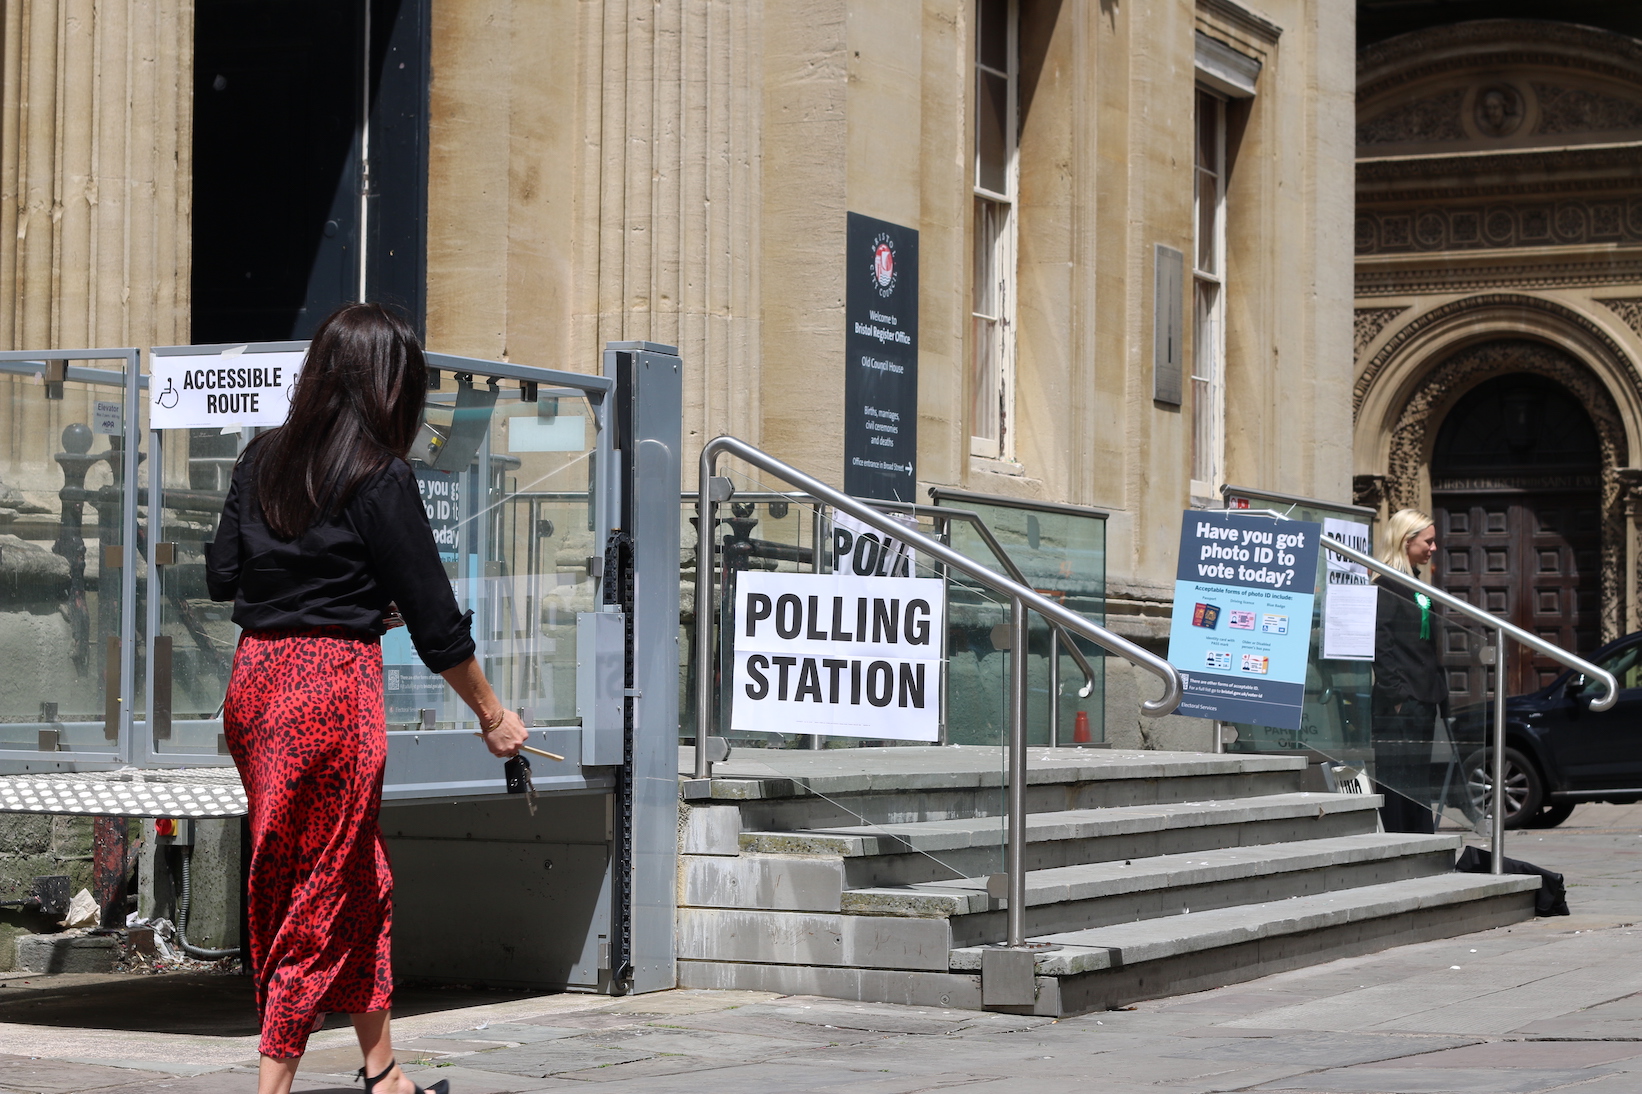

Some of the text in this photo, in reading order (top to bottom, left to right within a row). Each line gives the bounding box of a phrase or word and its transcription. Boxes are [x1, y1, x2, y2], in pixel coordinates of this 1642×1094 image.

[869, 310, 897, 326] Welcome to
[854, 322, 911, 345] Bristol Register Office
[862, 356, 904, 374] Old Council House
[184, 367, 282, 390] ACCESSIBLE
[98, 403, 119, 412] Elevator
[207, 393, 259, 414] ROUTE
[864, 406, 900, 422] Births, marriages,
[866, 420, 898, 434] civil ceremonies
[871, 436, 894, 447] and deaths
[852, 457, 863, 466] Office
[864, 460, 879, 468] entrance
[884, 462, 893, 470] Broad
[894, 463, 904, 472] Street
[428, 480, 449, 499] you
[437, 500, 450, 520] ID
[1196, 522, 1305, 549] Have you got
[1200, 542, 1295, 566] photo ID to
[1198, 563, 1295, 588] vote today?
[1195, 585, 1224, 595] Acceptable
[1248, 590, 1263, 598] photo
[746, 592, 931, 645] POLLING
[745, 654, 925, 709] STATION
